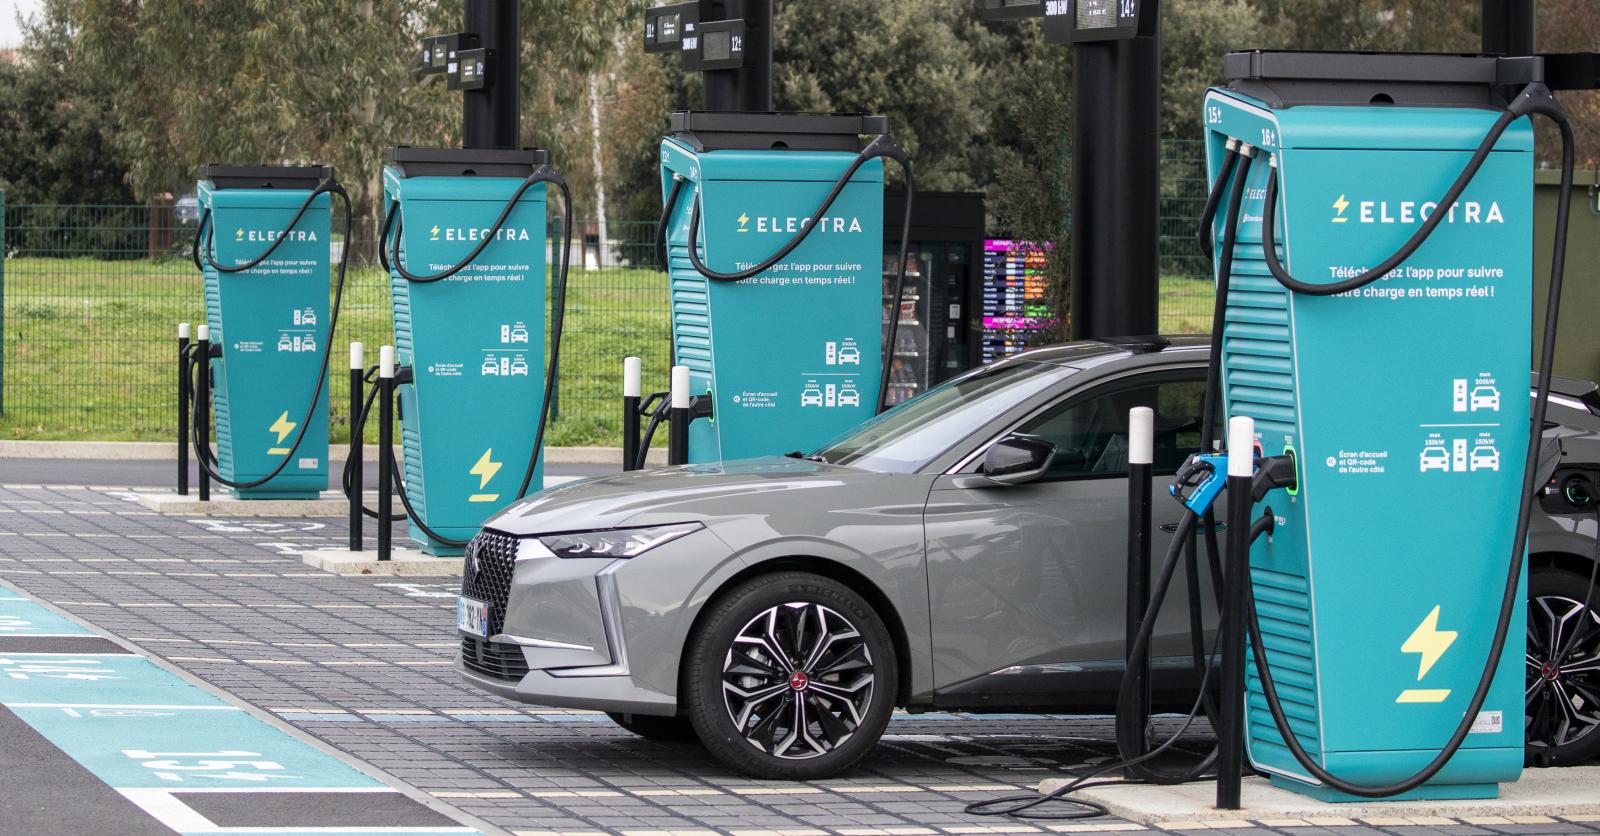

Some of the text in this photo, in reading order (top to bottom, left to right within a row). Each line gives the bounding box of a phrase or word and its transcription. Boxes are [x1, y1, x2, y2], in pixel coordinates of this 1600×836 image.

[1208, 106, 1218, 124] 15
[1262, 128, 1271, 146] 16
[1360, 201, 1504, 223] ELECTRA
[757, 217, 862, 233] ELECTRA
[446, 228, 530, 241] ELECTRA
[491, 264, 506, 272] pour
[508, 263, 529, 271] suivre
[813, 263, 833, 272] pour
[835, 262, 862, 271] suivre
[448, 274, 472, 283] charge
[1329, 266, 1403, 280] Téléchgez
[1437, 268, 1465, 280] pour
[1467, 266, 1504, 278] suivre
[759, 276, 790, 285] charge
[805, 276, 831, 285] temps
[1363, 286, 1405, 299] charge
[1408, 288, 1422, 297] en
[1426, 287, 1463, 299] temps
[1339, 449, 1358, 458] Écran
[1347, 458, 1376, 466] QR-code
[1369, 465, 1385, 473] côté
